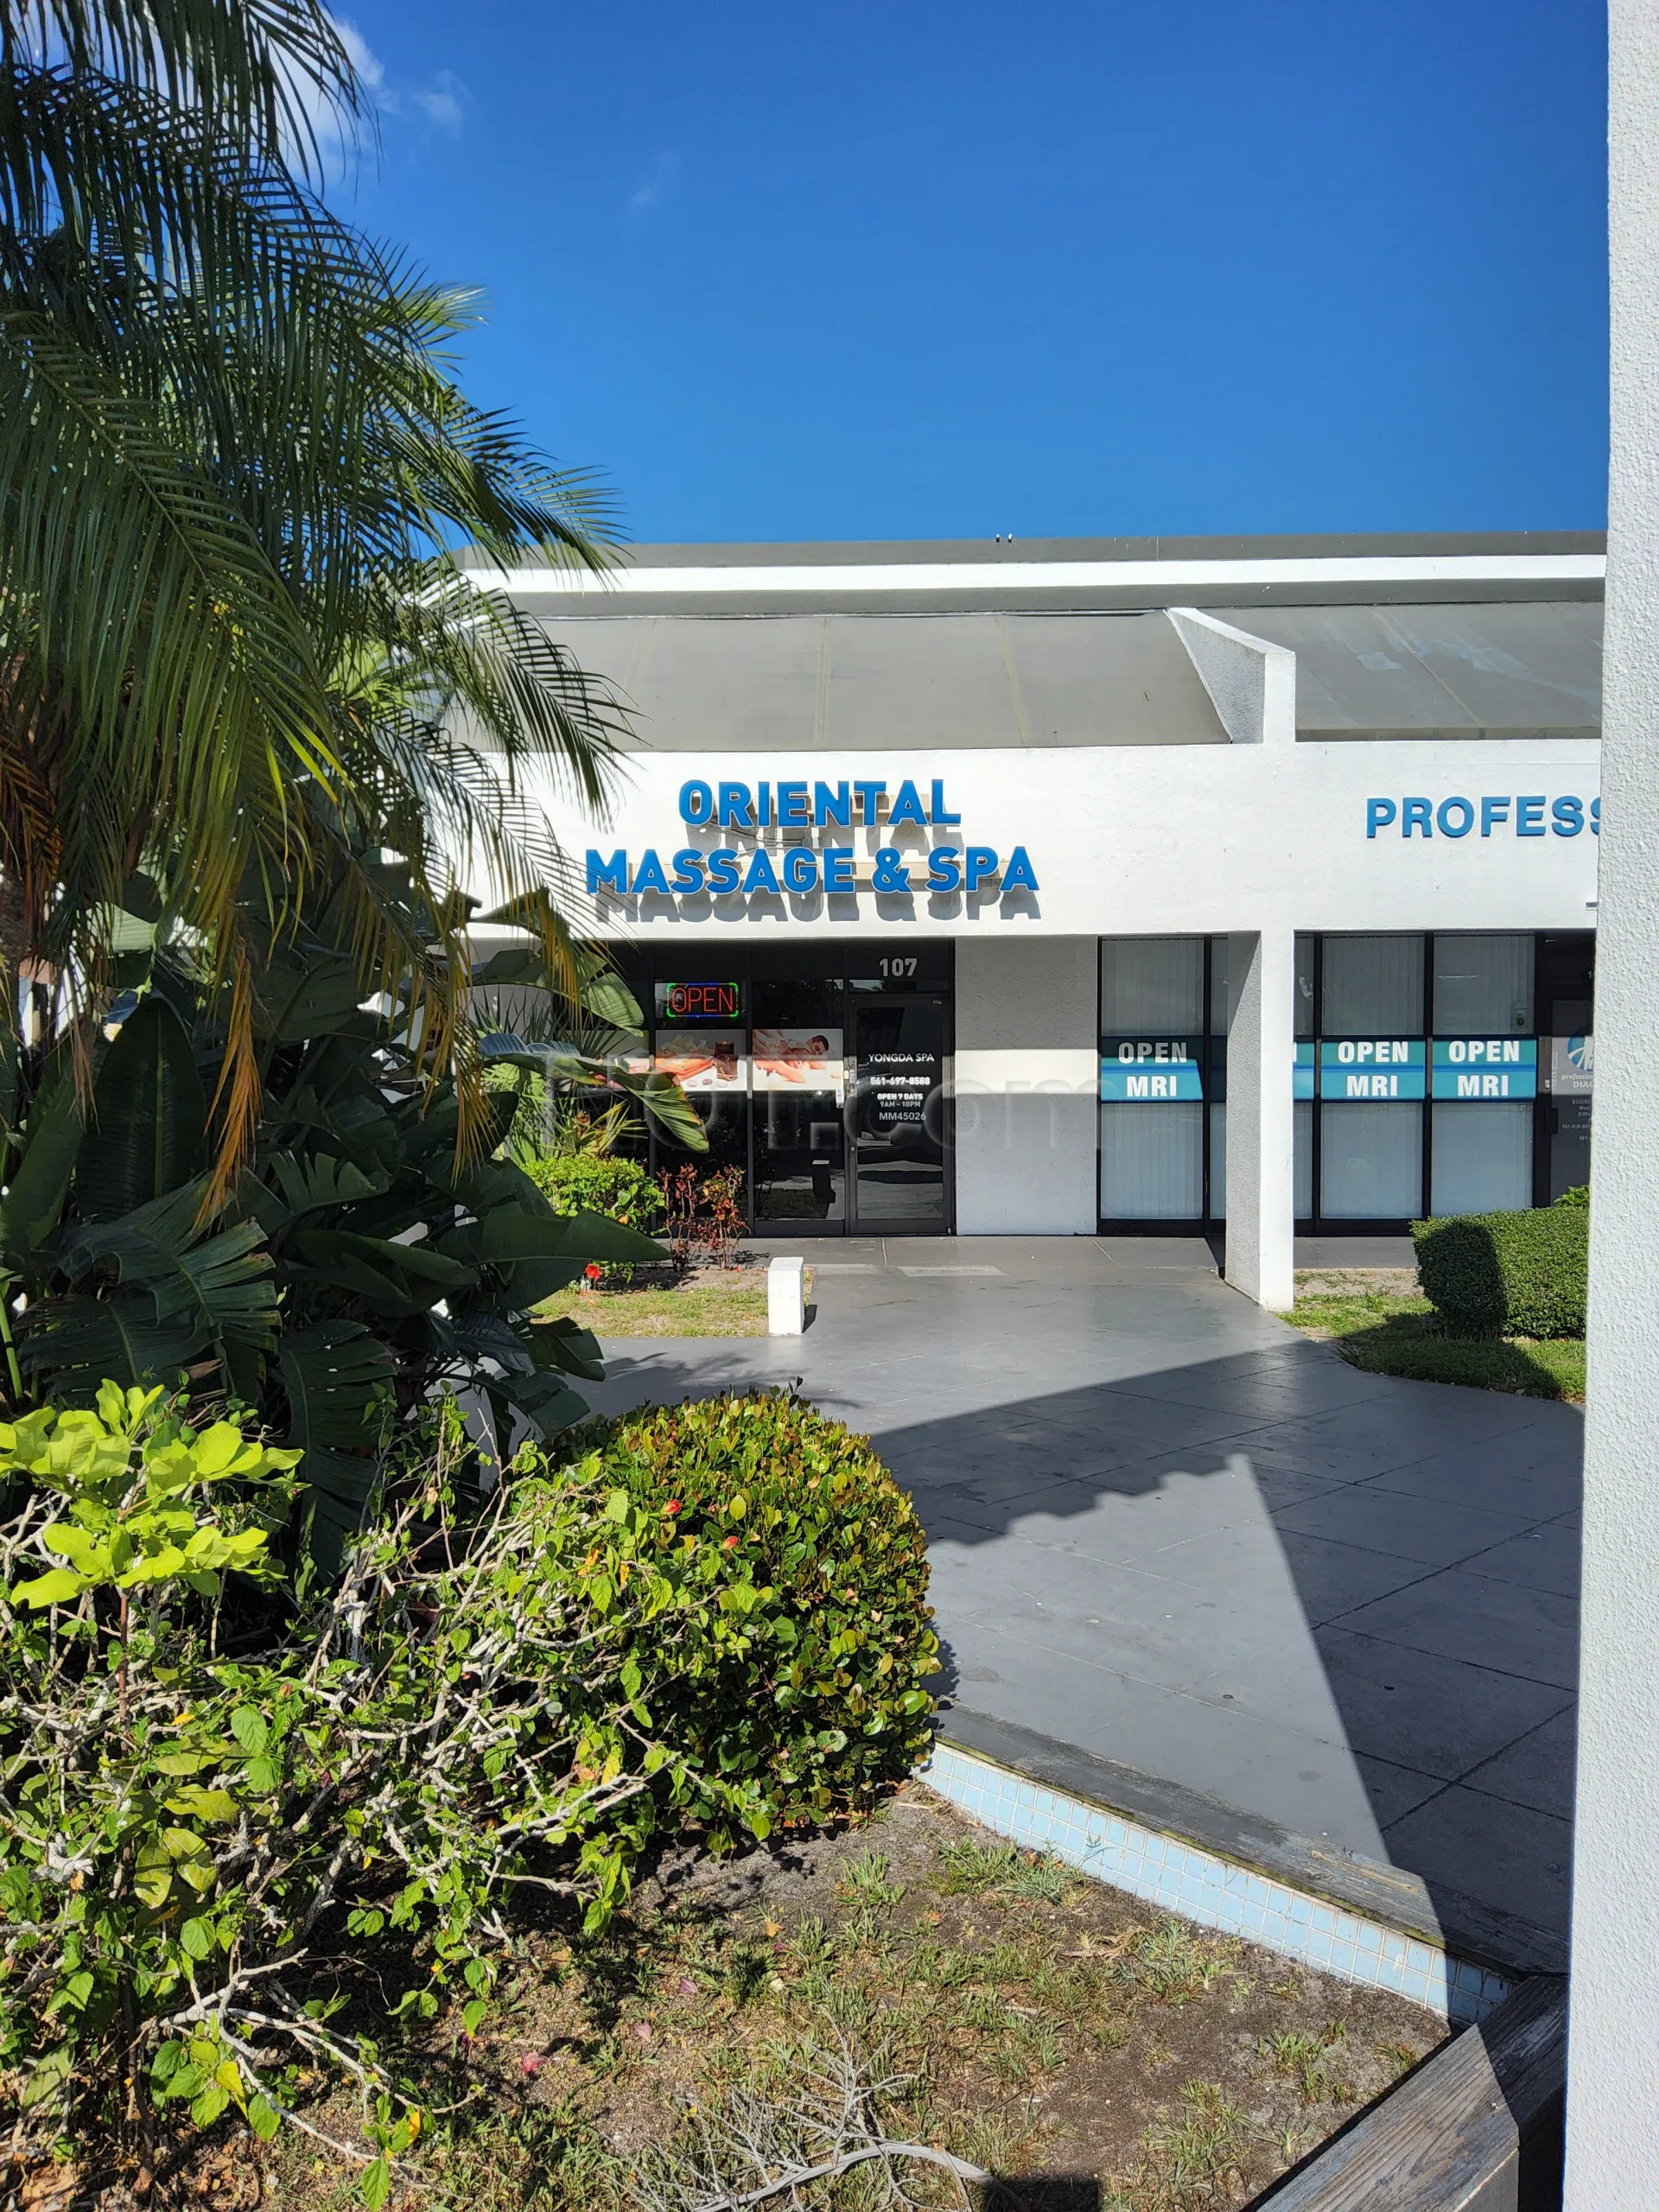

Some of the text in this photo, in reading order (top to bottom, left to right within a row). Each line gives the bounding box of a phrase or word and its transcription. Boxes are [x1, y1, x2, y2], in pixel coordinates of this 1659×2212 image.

[678, 779, 962, 827] ORIENTAL
[585, 845, 1040, 894] MASSAGE & SPA
[879, 957, 918, 977] 107
[671, 987, 734, 1013] OPEN
[868, 1052, 935, 1063] YONGDA SPA
[1118, 1041, 1187, 1064] OPEN
[1337, 1040, 1409, 1063] OPEN
[1447, 1039, 1520, 1063] OPEN
[1126, 1075, 1177, 1097] MRI
[1345, 1074, 1398, 1097] MRI
[1456, 1074, 1509, 1097] MRI
[878, 1111, 927, 1122] MM45026
